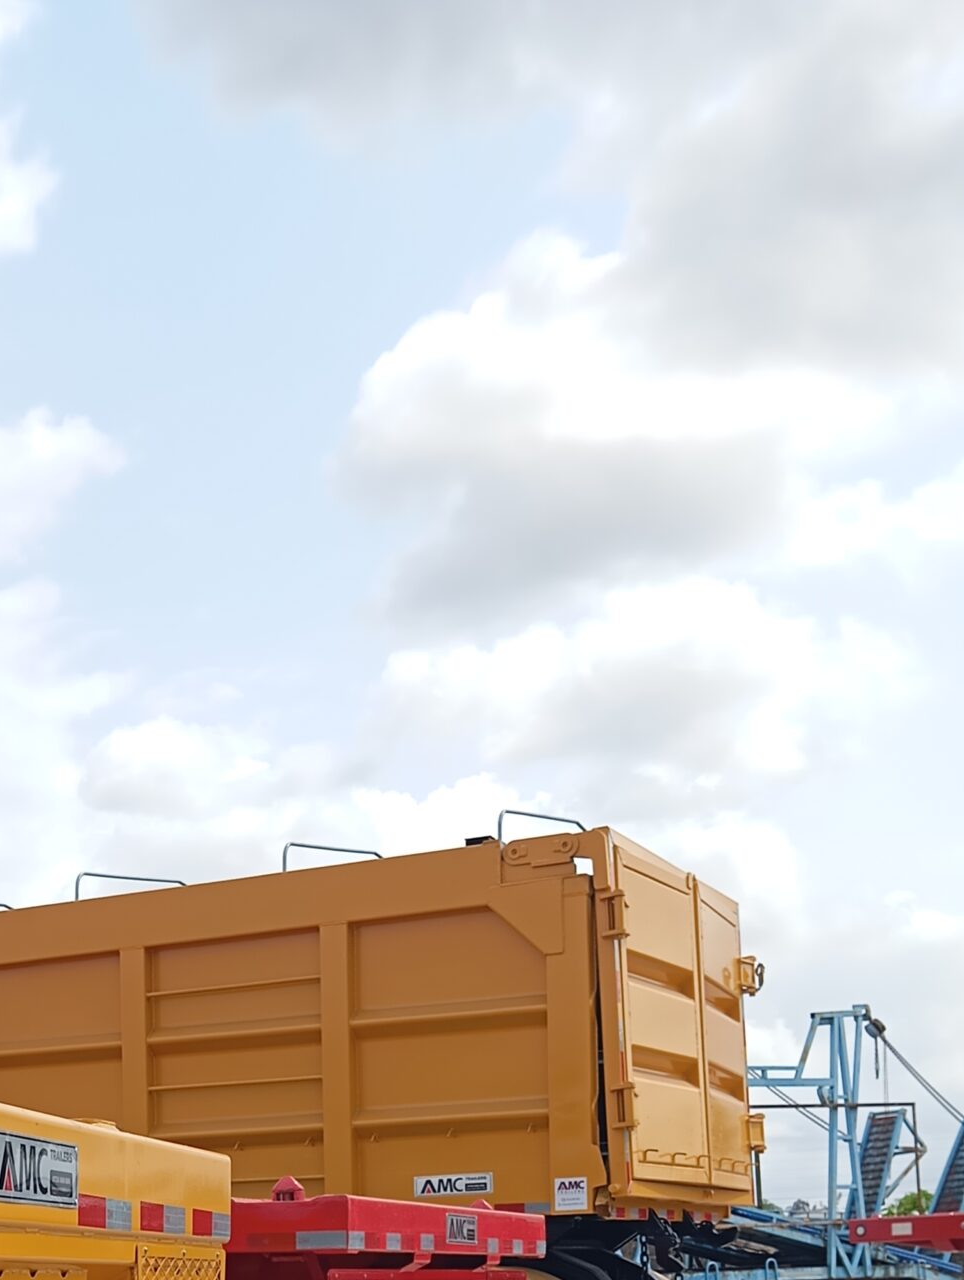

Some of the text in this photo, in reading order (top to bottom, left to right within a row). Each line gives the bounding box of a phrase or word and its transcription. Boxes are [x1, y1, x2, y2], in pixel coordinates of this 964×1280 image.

[421, 1177, 463, 1195] AMC
[558, 1180, 585, 1191] AMC
[449, 1218, 467, 1241] AMC
